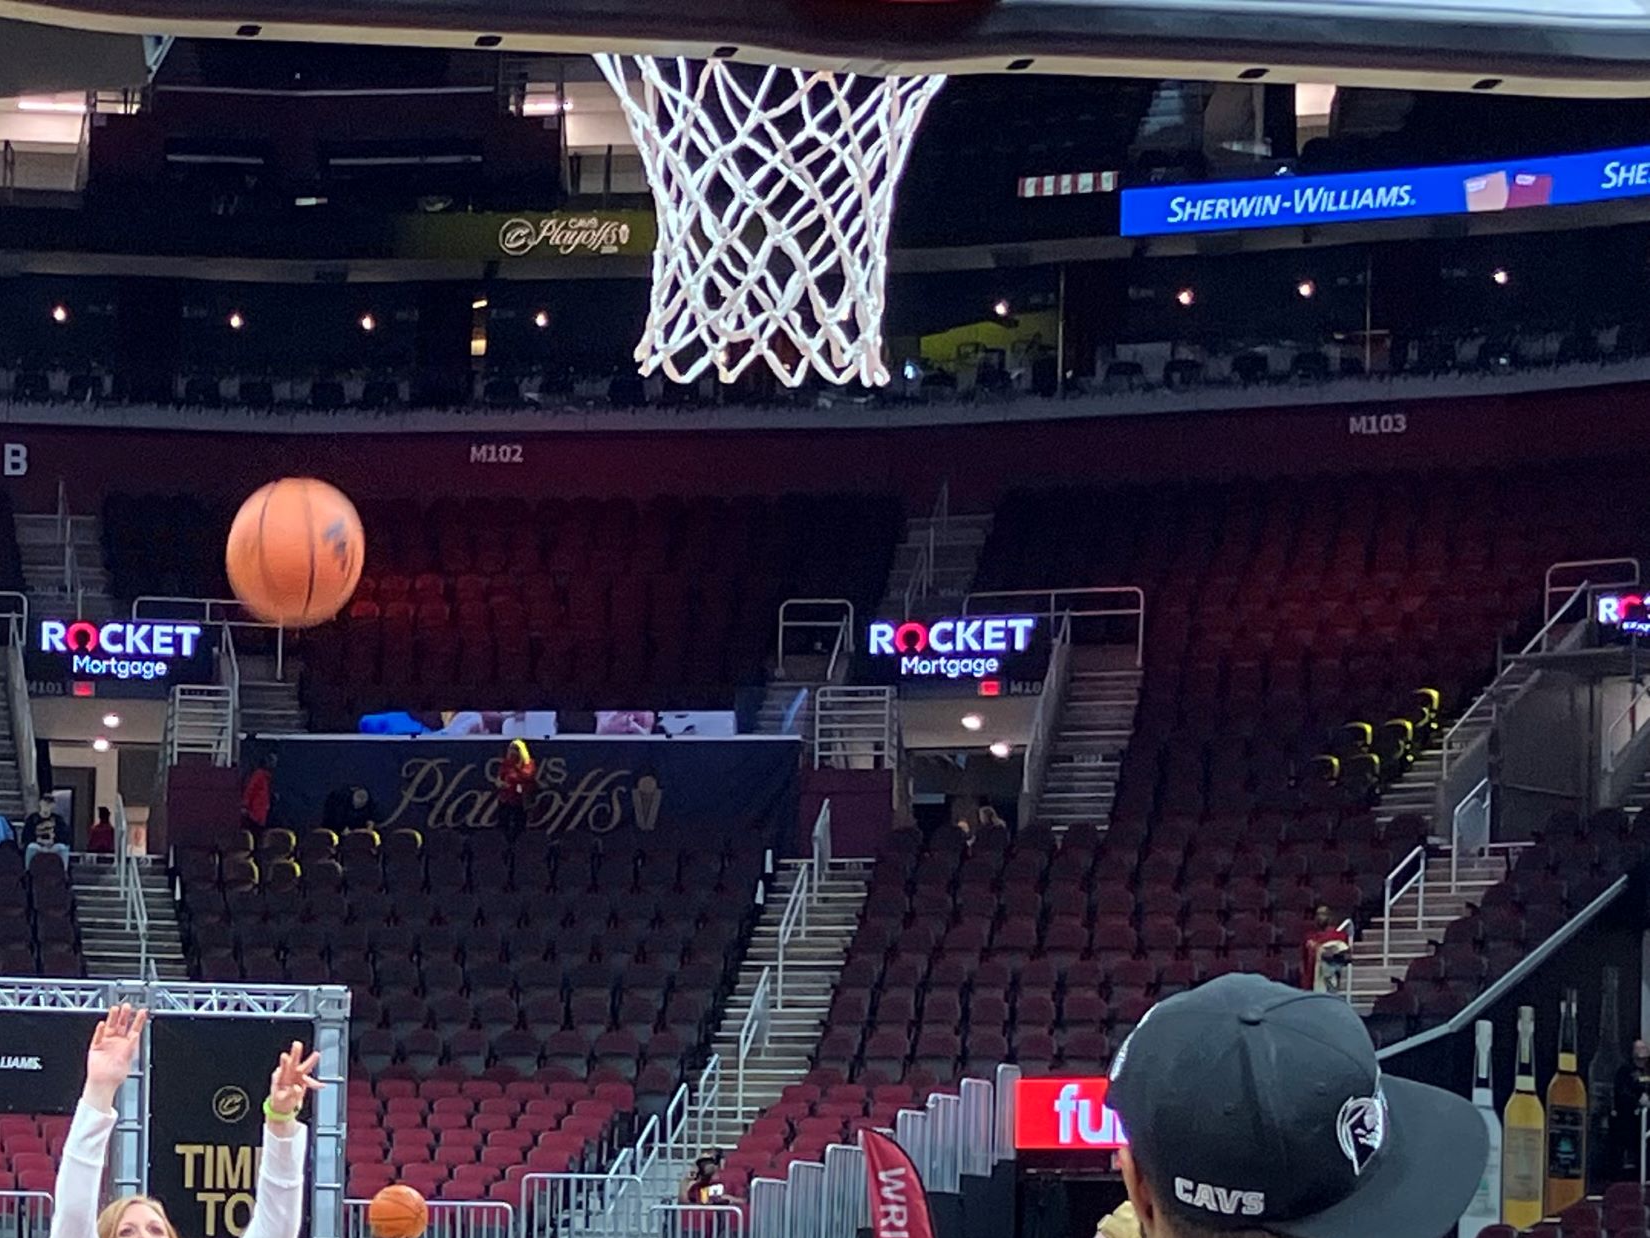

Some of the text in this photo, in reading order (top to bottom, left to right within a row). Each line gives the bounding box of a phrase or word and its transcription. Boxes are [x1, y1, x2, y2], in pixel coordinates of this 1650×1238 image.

[527, 219, 619, 254] Playoffs
[1350, 415, 1407, 434] M103
[470, 445, 524, 463] M102
[41, 620, 200, 656] ROCKET
[869, 618, 1034, 655] ROCKET
[73, 654, 167, 679] Mortgage
[901, 656, 999, 678] Mortgage
[1009, 681, 1043, 695] M10
[377, 757, 632, 835] Plaoffs
[175, 1143, 262, 1190] TIM
[1174, 1177, 1265, 1215] CAVS
[196, 1192, 258, 1238] TO
